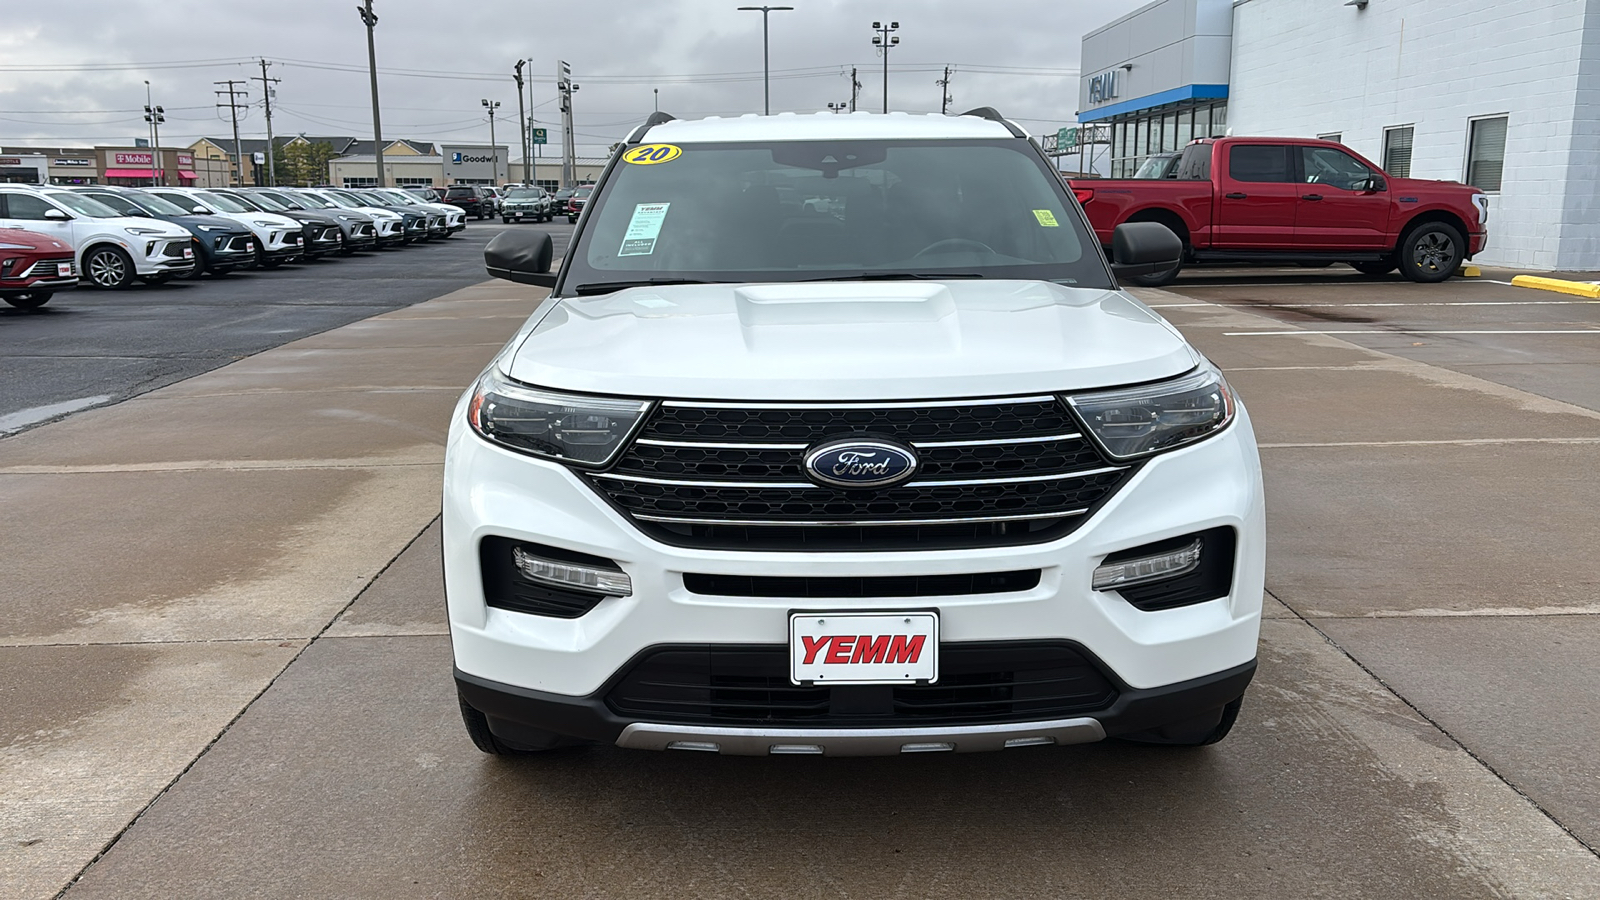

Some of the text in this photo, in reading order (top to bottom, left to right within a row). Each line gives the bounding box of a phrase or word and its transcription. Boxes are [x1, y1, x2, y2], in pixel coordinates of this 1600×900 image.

[125, 155, 151, 163] Mobile
[462, 155, 498, 163] Goodwil
[632, 147, 670, 161] 20
[832, 451, 891, 475] Ford
[801, 635, 927, 664] YEMM
